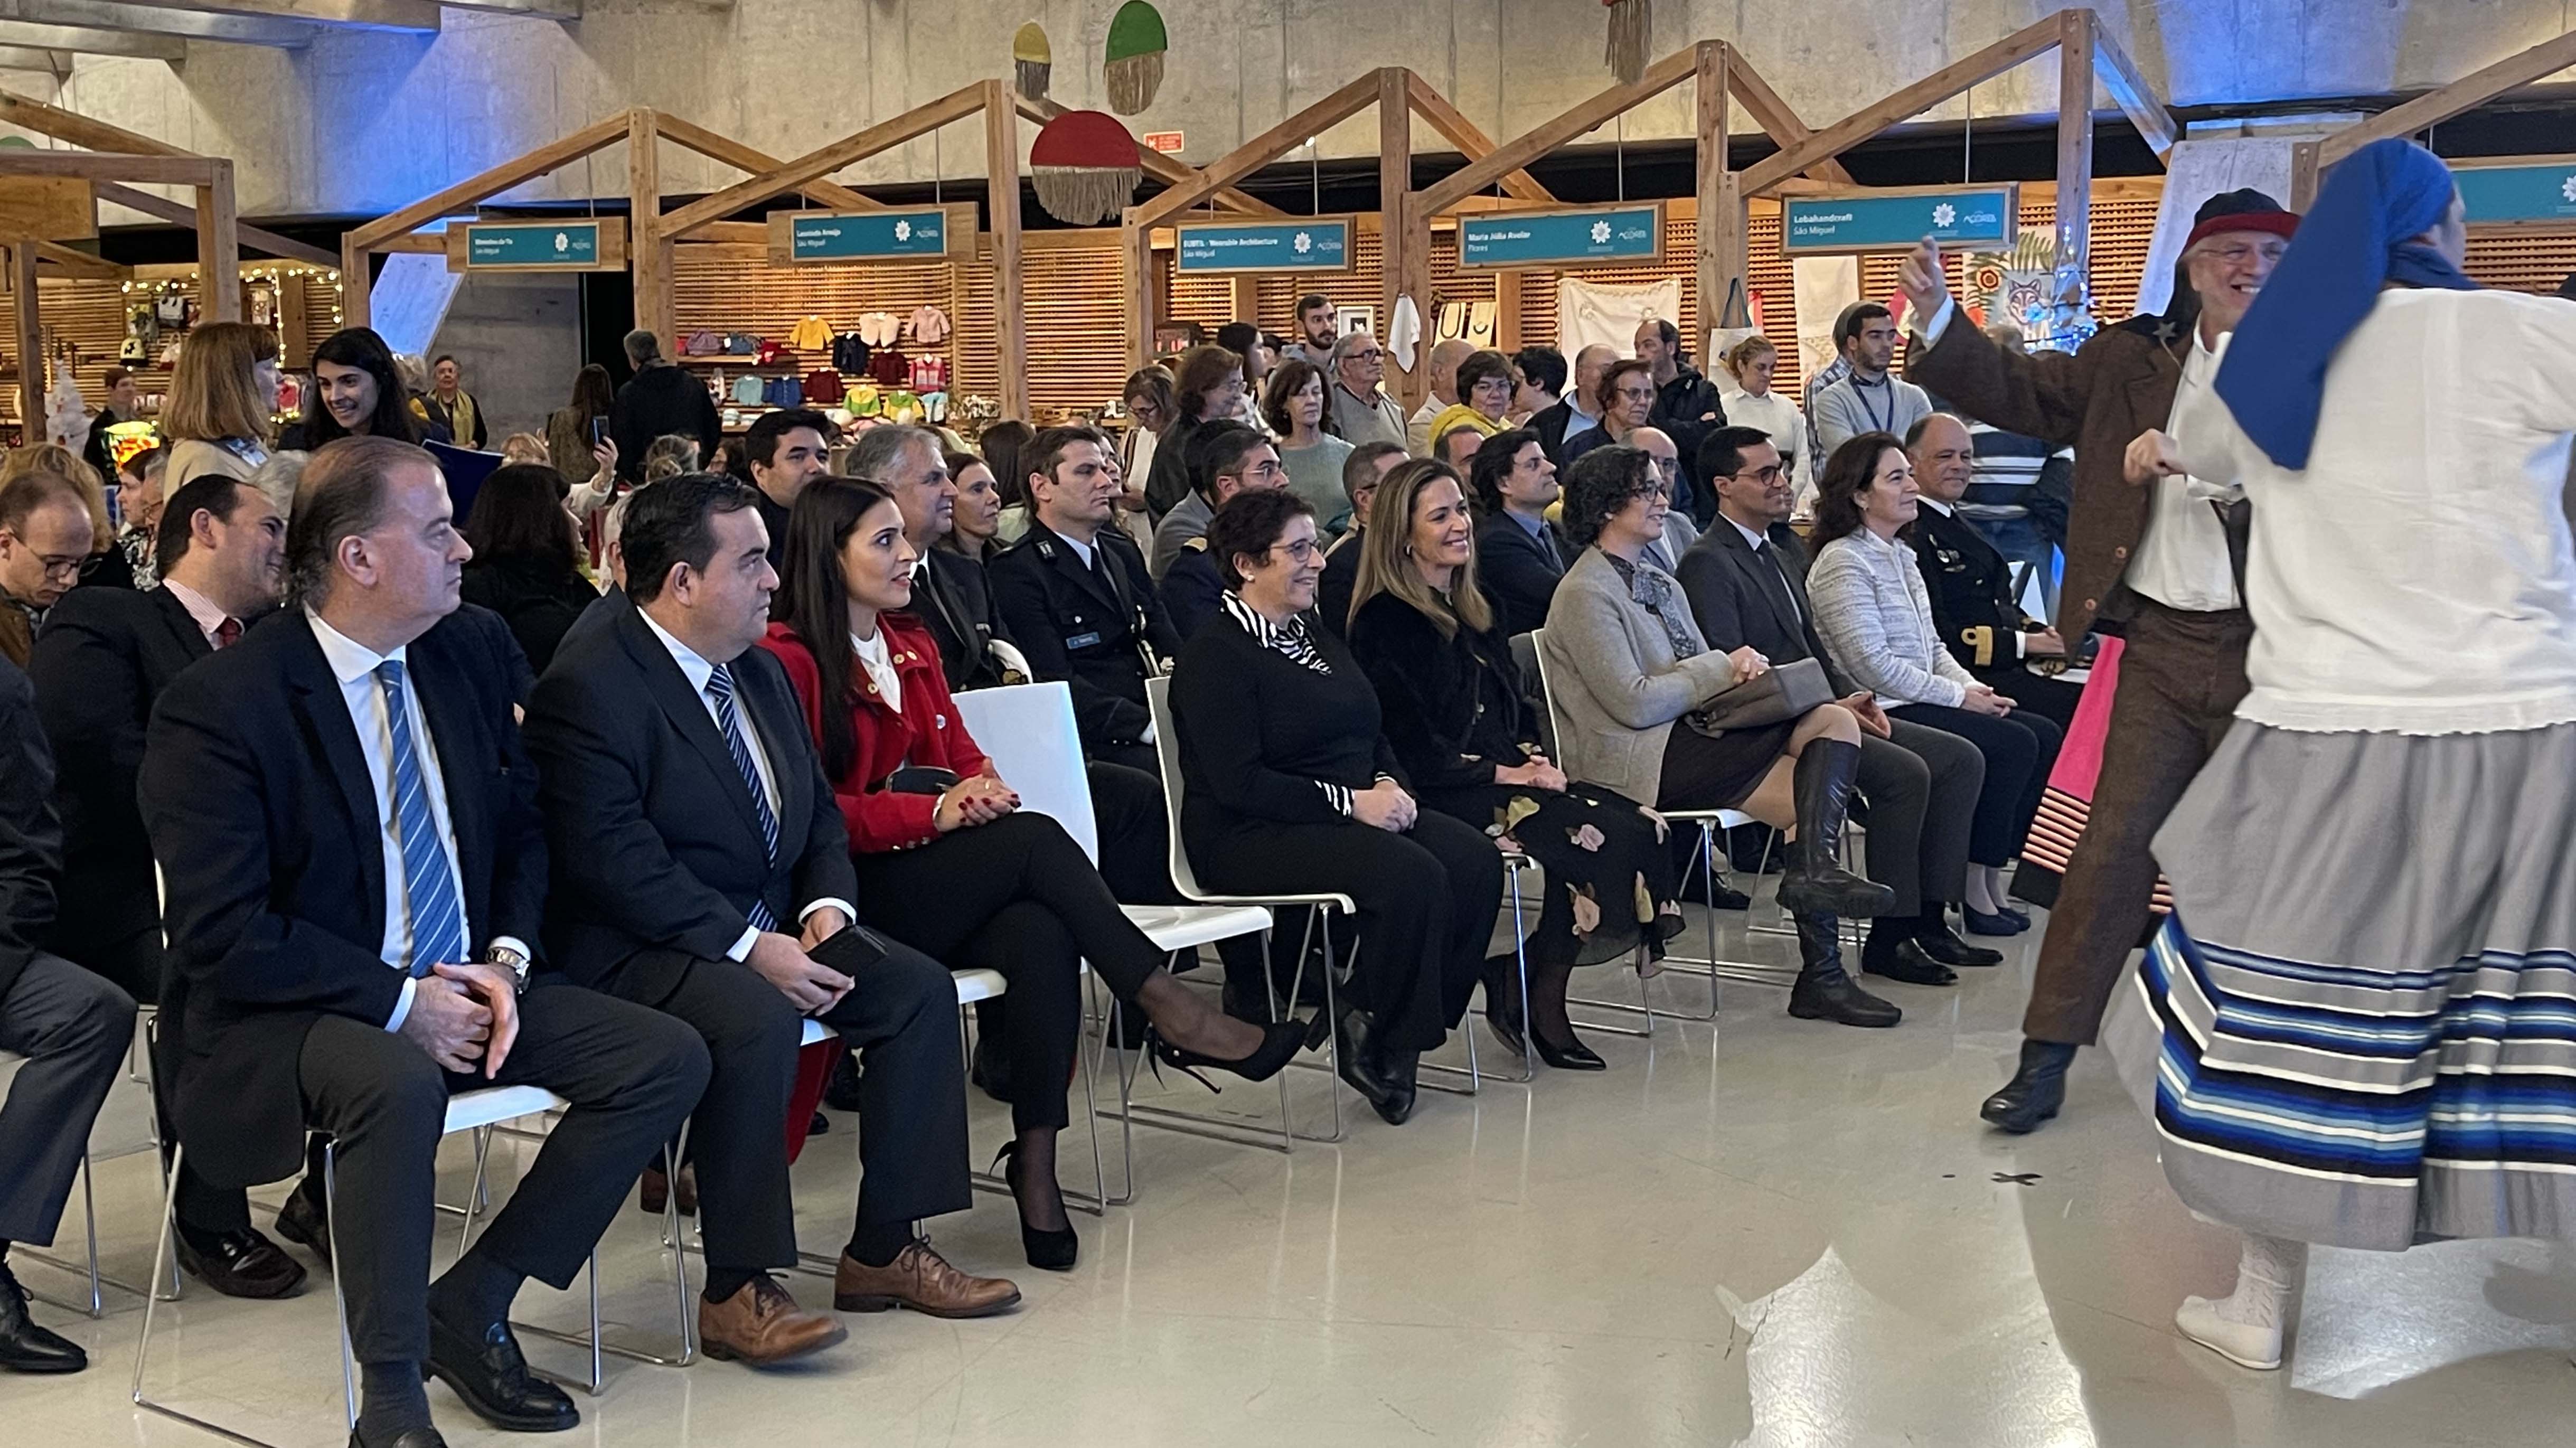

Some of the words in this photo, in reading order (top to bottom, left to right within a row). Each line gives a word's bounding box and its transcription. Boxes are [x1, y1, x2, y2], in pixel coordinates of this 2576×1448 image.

[1793, 226, 1808, 235] São
[1809, 225, 1835, 236] Miguel
[1468, 244, 1488, 252] Flores
